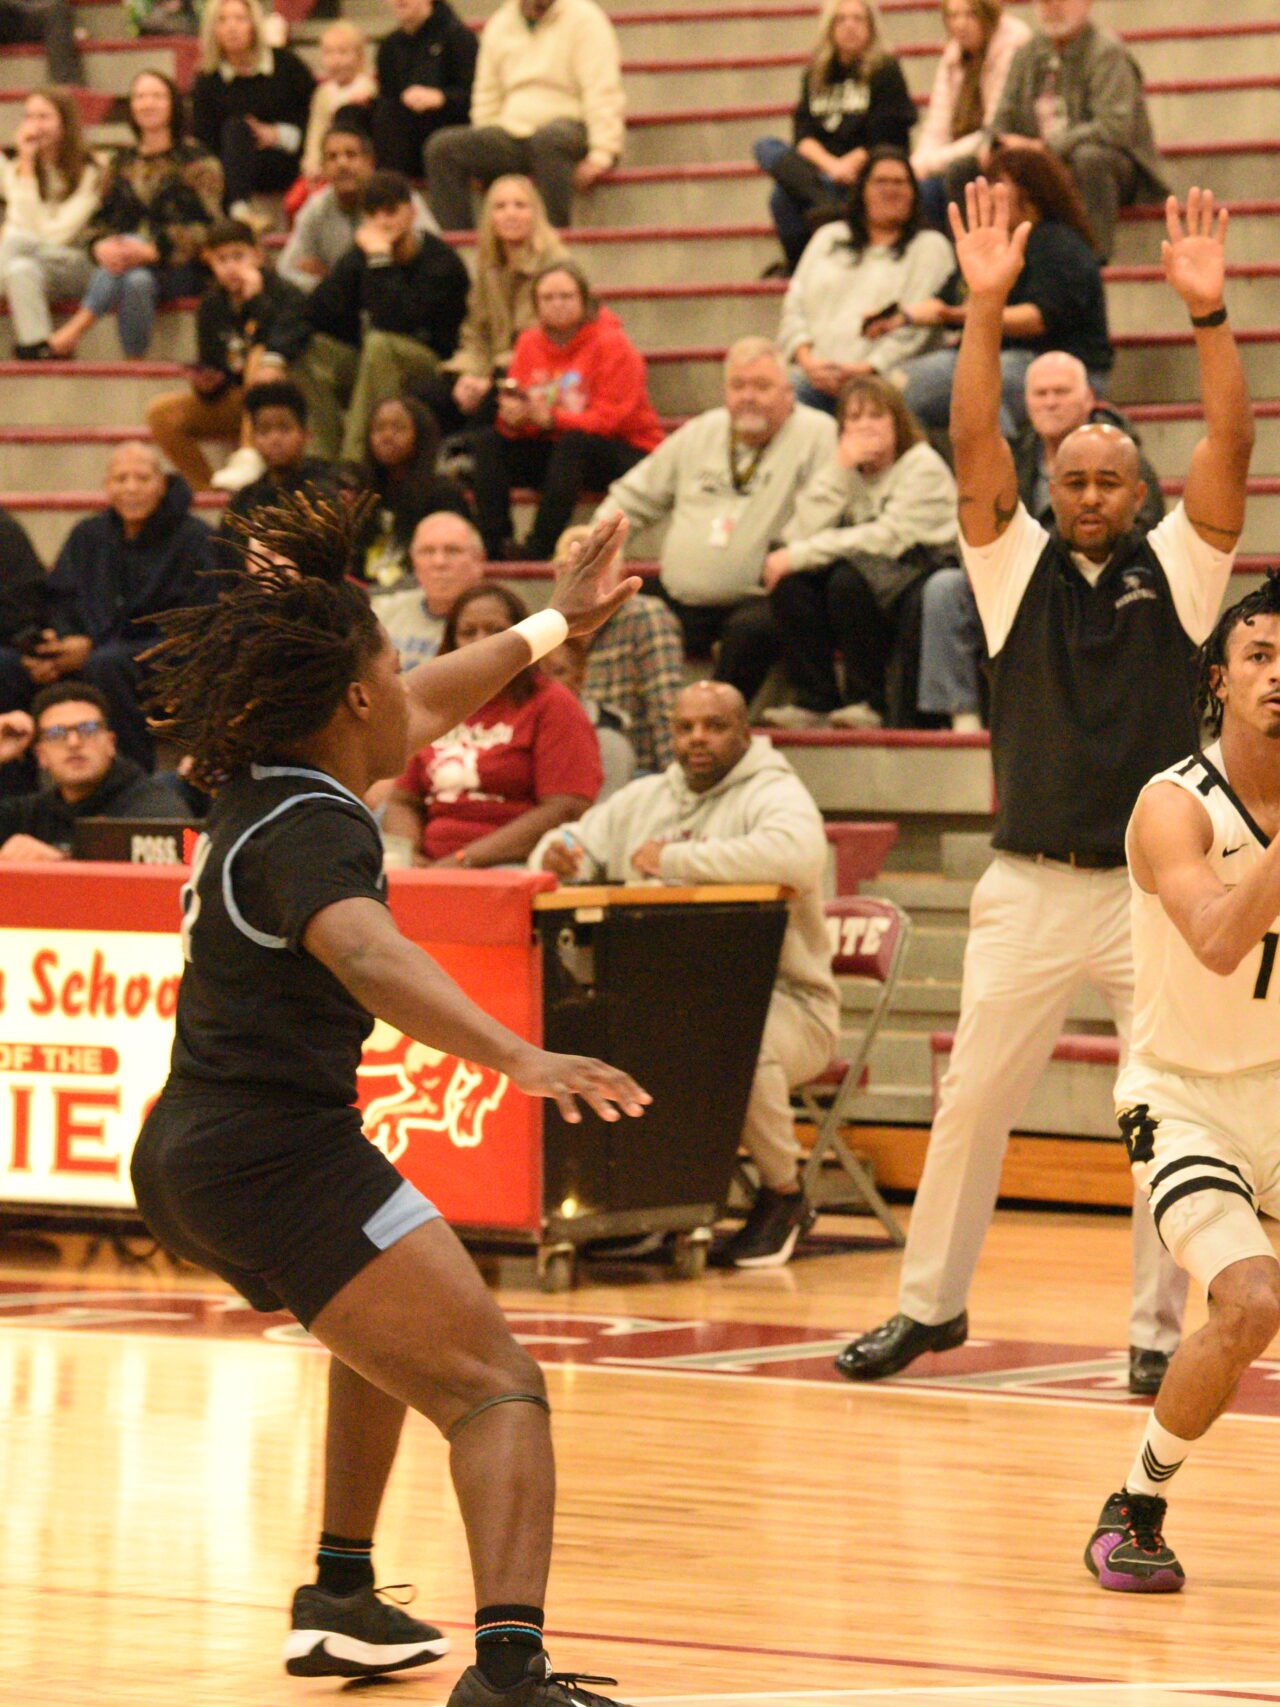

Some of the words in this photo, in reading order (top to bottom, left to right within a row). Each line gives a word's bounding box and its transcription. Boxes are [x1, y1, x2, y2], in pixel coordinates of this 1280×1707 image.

[29, 948, 181, 1019] Schoo
[43, 1046, 102, 1074] THE
[8, 1084, 160, 1182] IE
